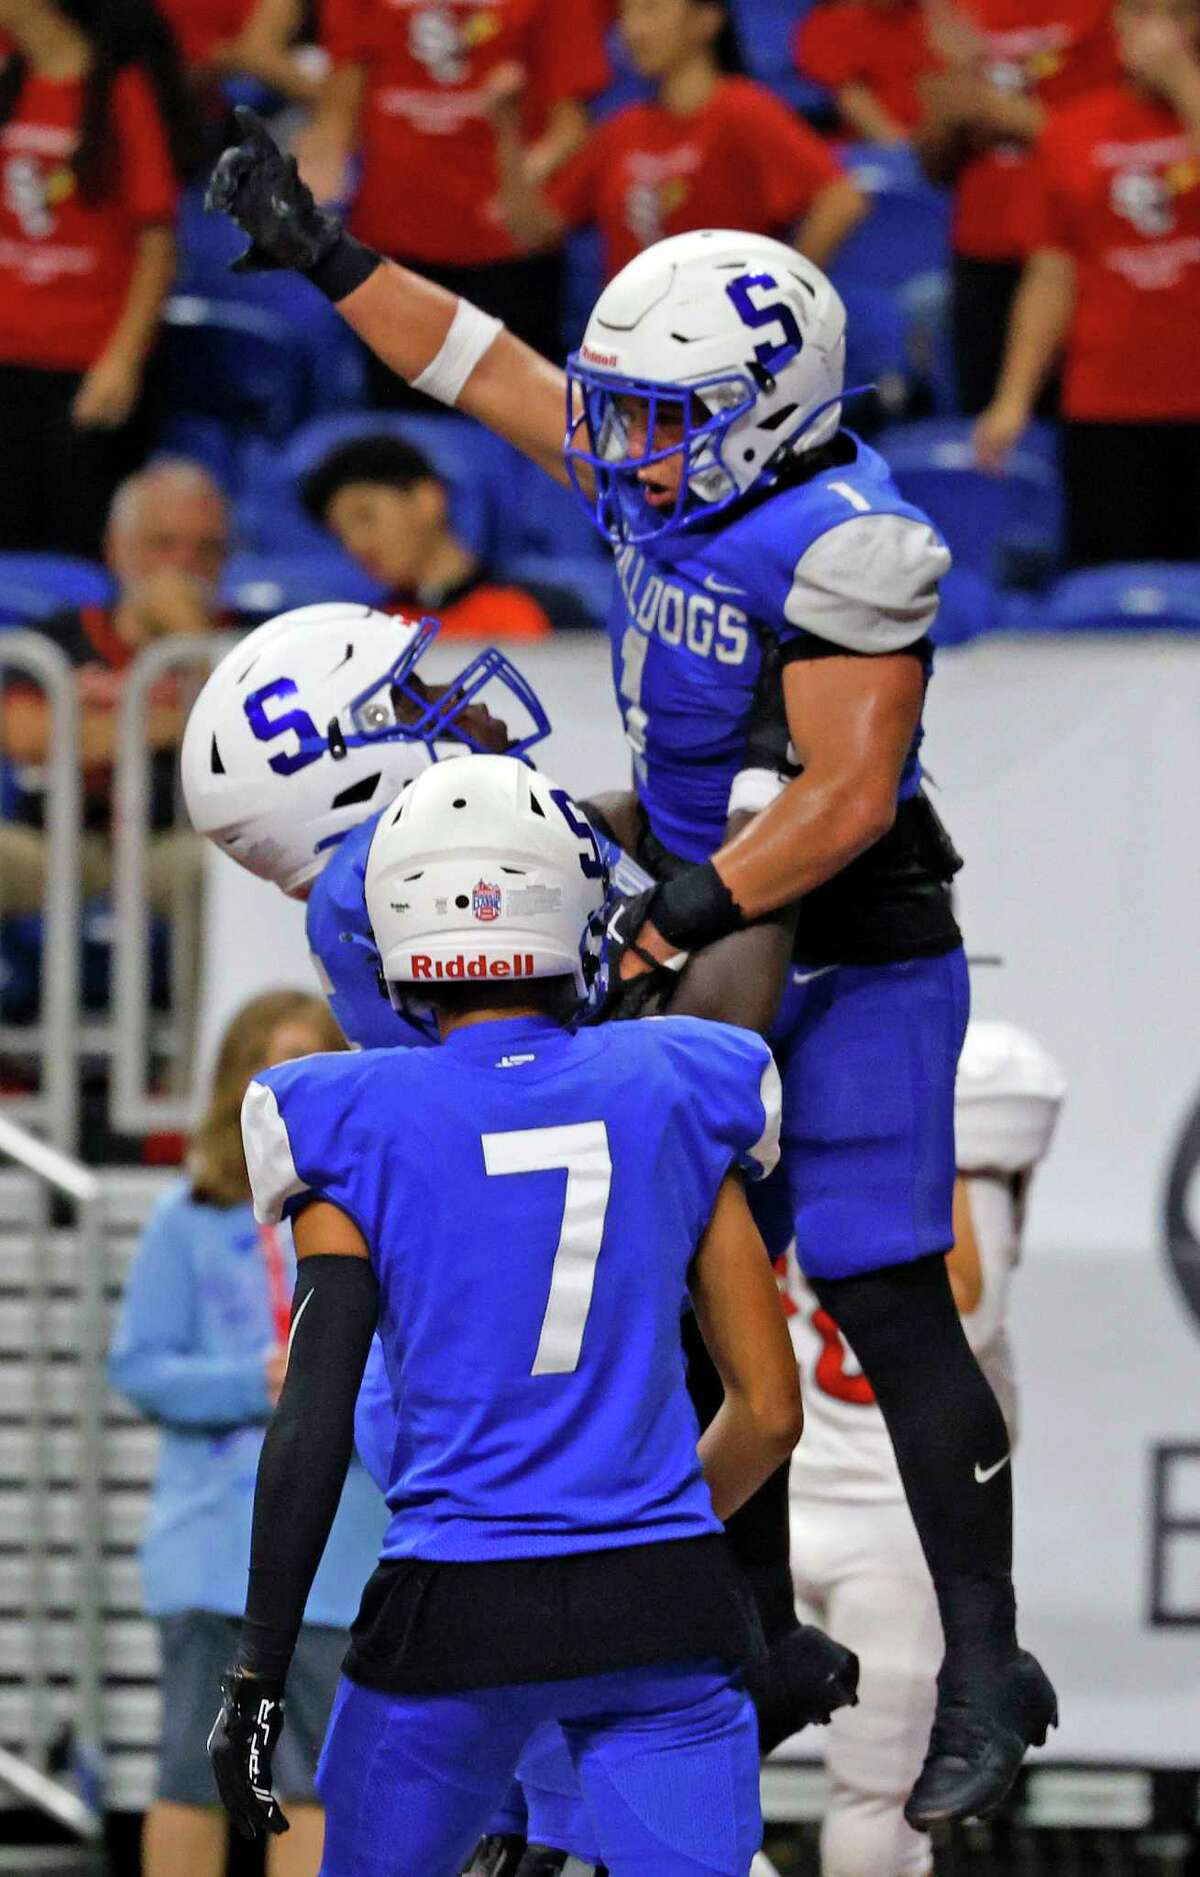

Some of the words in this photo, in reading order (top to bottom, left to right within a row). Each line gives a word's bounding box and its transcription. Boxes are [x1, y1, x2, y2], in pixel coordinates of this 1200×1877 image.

[725, 273, 803, 375] S
[827, 481, 870, 511] 1
[611, 522, 748, 665] LLDOGS
[243, 677, 323, 775] S
[549, 790, 602, 878] S
[411, 954, 534, 978] Riddell
[481, 1120, 613, 1376] 7
